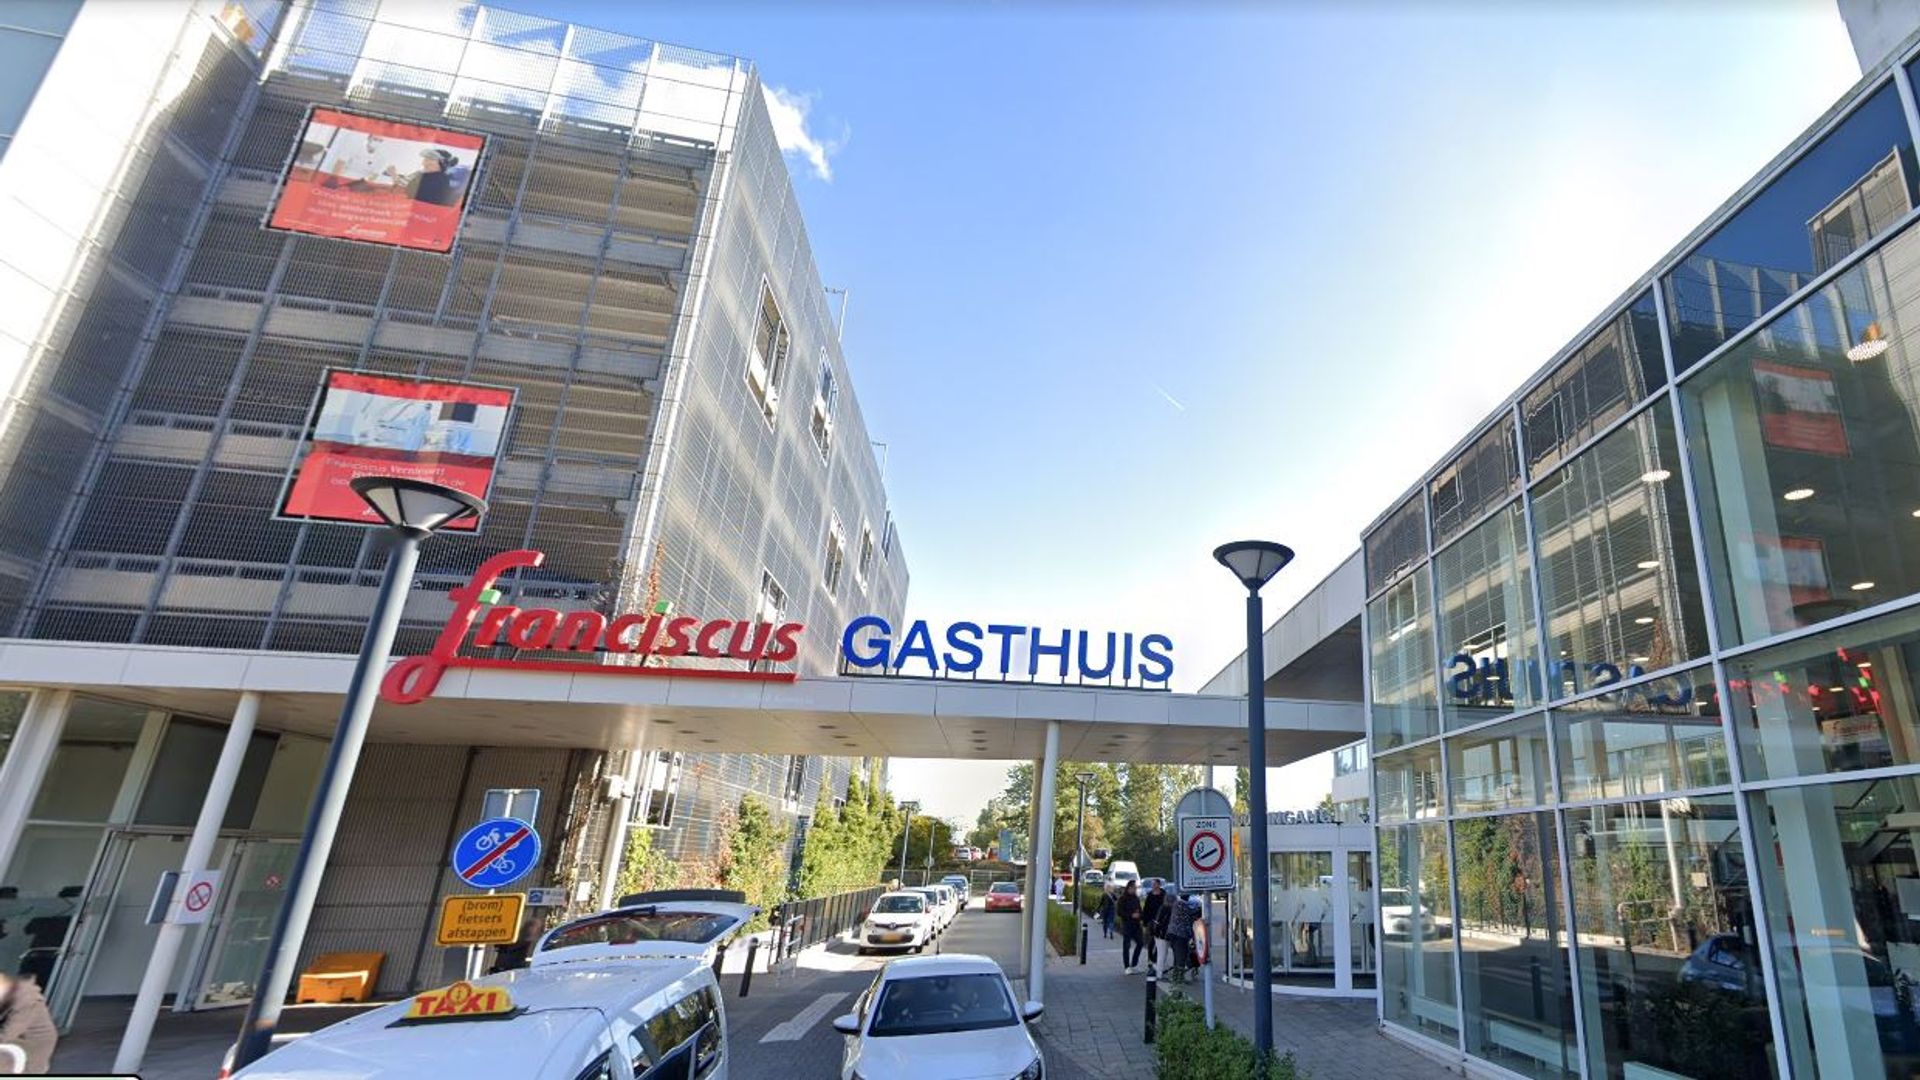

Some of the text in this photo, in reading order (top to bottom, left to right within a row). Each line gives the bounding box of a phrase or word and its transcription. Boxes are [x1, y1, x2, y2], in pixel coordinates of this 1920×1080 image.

[842, 615, 1174, 682] GASTHUIS
[1195, 820, 1217, 829] ZONE
[462, 899, 503, 913] (brom)
[457, 913, 503, 924] fietsers
[447, 927, 507, 939] afstappen
[415, 992, 497, 1016] TAXI
